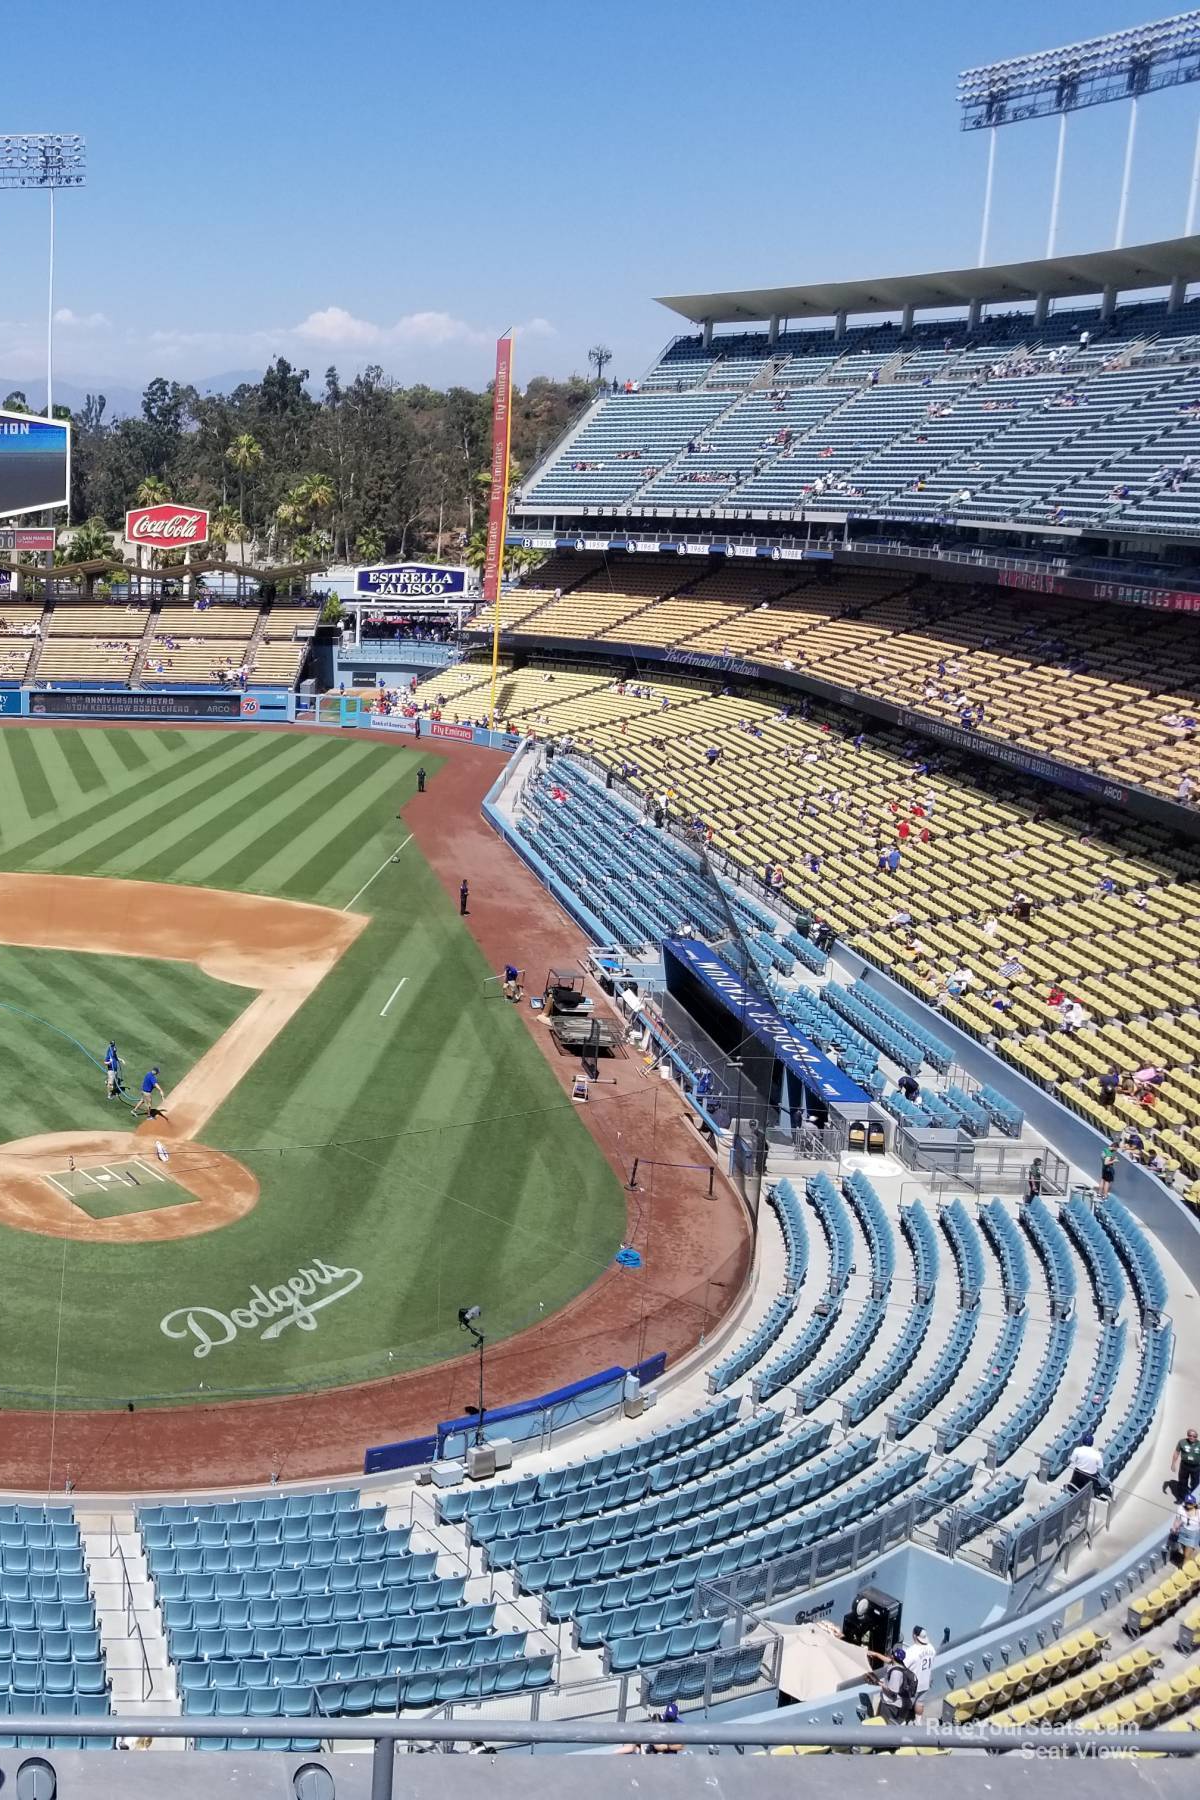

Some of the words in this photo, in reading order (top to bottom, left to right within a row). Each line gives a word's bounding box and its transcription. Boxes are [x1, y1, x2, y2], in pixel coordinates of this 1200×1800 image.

[496, 361, 506, 403] Emirates
[132, 514, 202, 538] Coca-Cola
[487, 521, 498, 561] Emirates
[368, 572, 453, 584] ESTRELLA
[376, 584, 444, 595] JALISCO
[207, 705, 230, 713] ARCO
[243, 701, 256, 711] 76
[433, 724, 444, 736] Fly
[444, 727, 471, 738] Emirates
[972, 736, 999, 756] CLAYTON
[1000, 744, 1031, 768] KERSHAW
[1104, 786, 1122, 800] ARCO
[695, 962, 762, 1007] STADIUM
[748, 1012, 821, 1063] DODGER
[159, 1258, 364, 1358] Dodgers
[921, 1658, 932, 1671] 21
